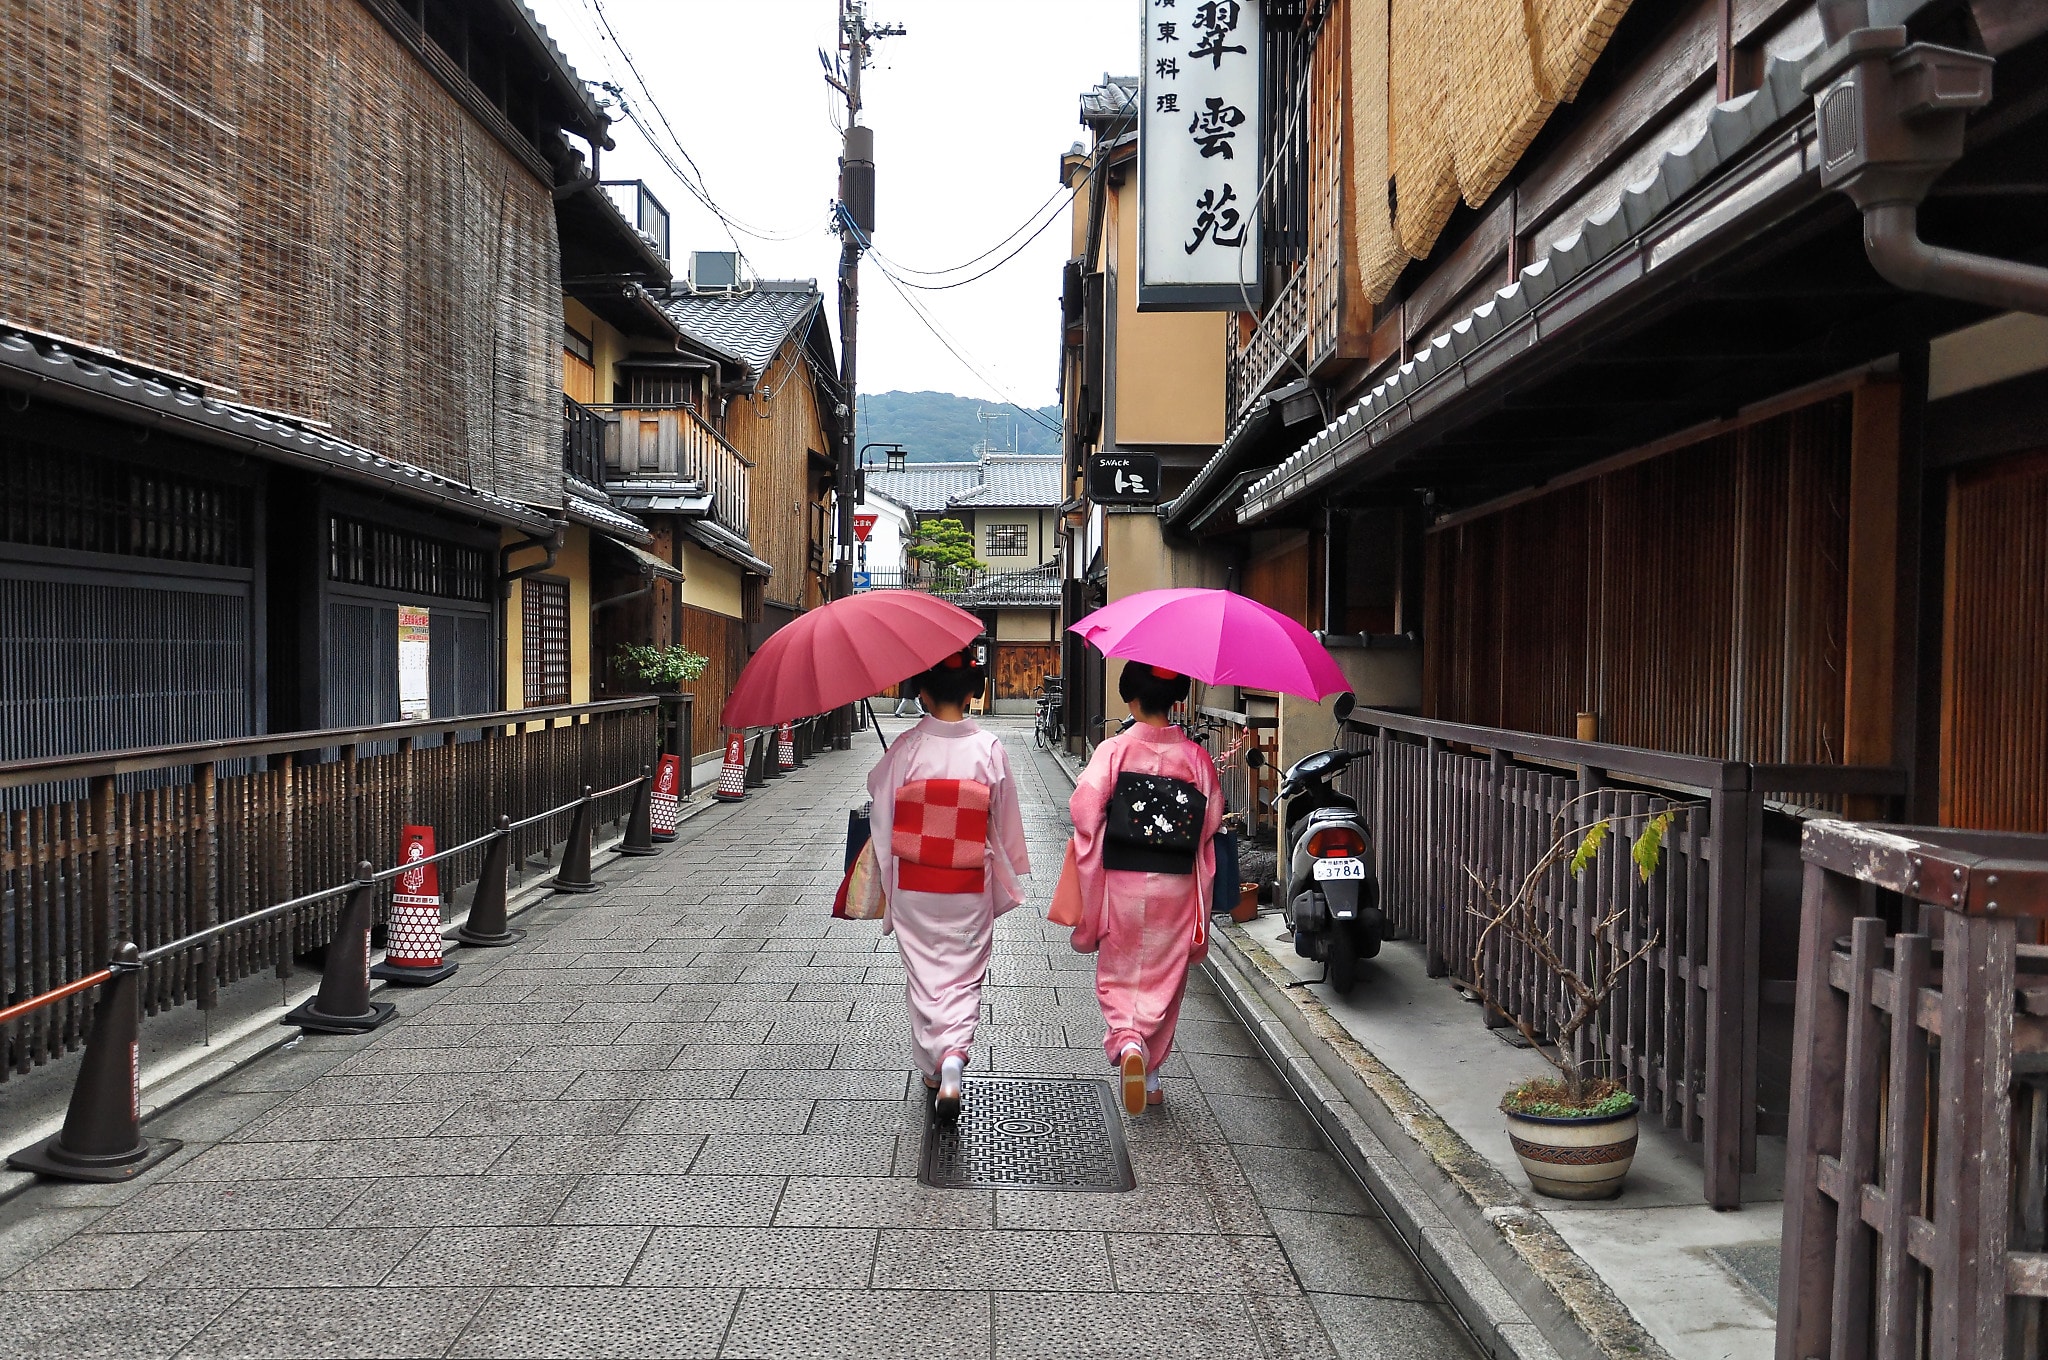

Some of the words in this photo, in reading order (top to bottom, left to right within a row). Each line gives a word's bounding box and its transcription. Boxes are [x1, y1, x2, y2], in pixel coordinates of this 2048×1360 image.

[1185, 1, 1247, 255] 翠雲苑
[1099, 459, 1130, 467] SNACK
[1115, 469, 1150, 494] トミ
[1326, 865, 1361, 877] 3784
